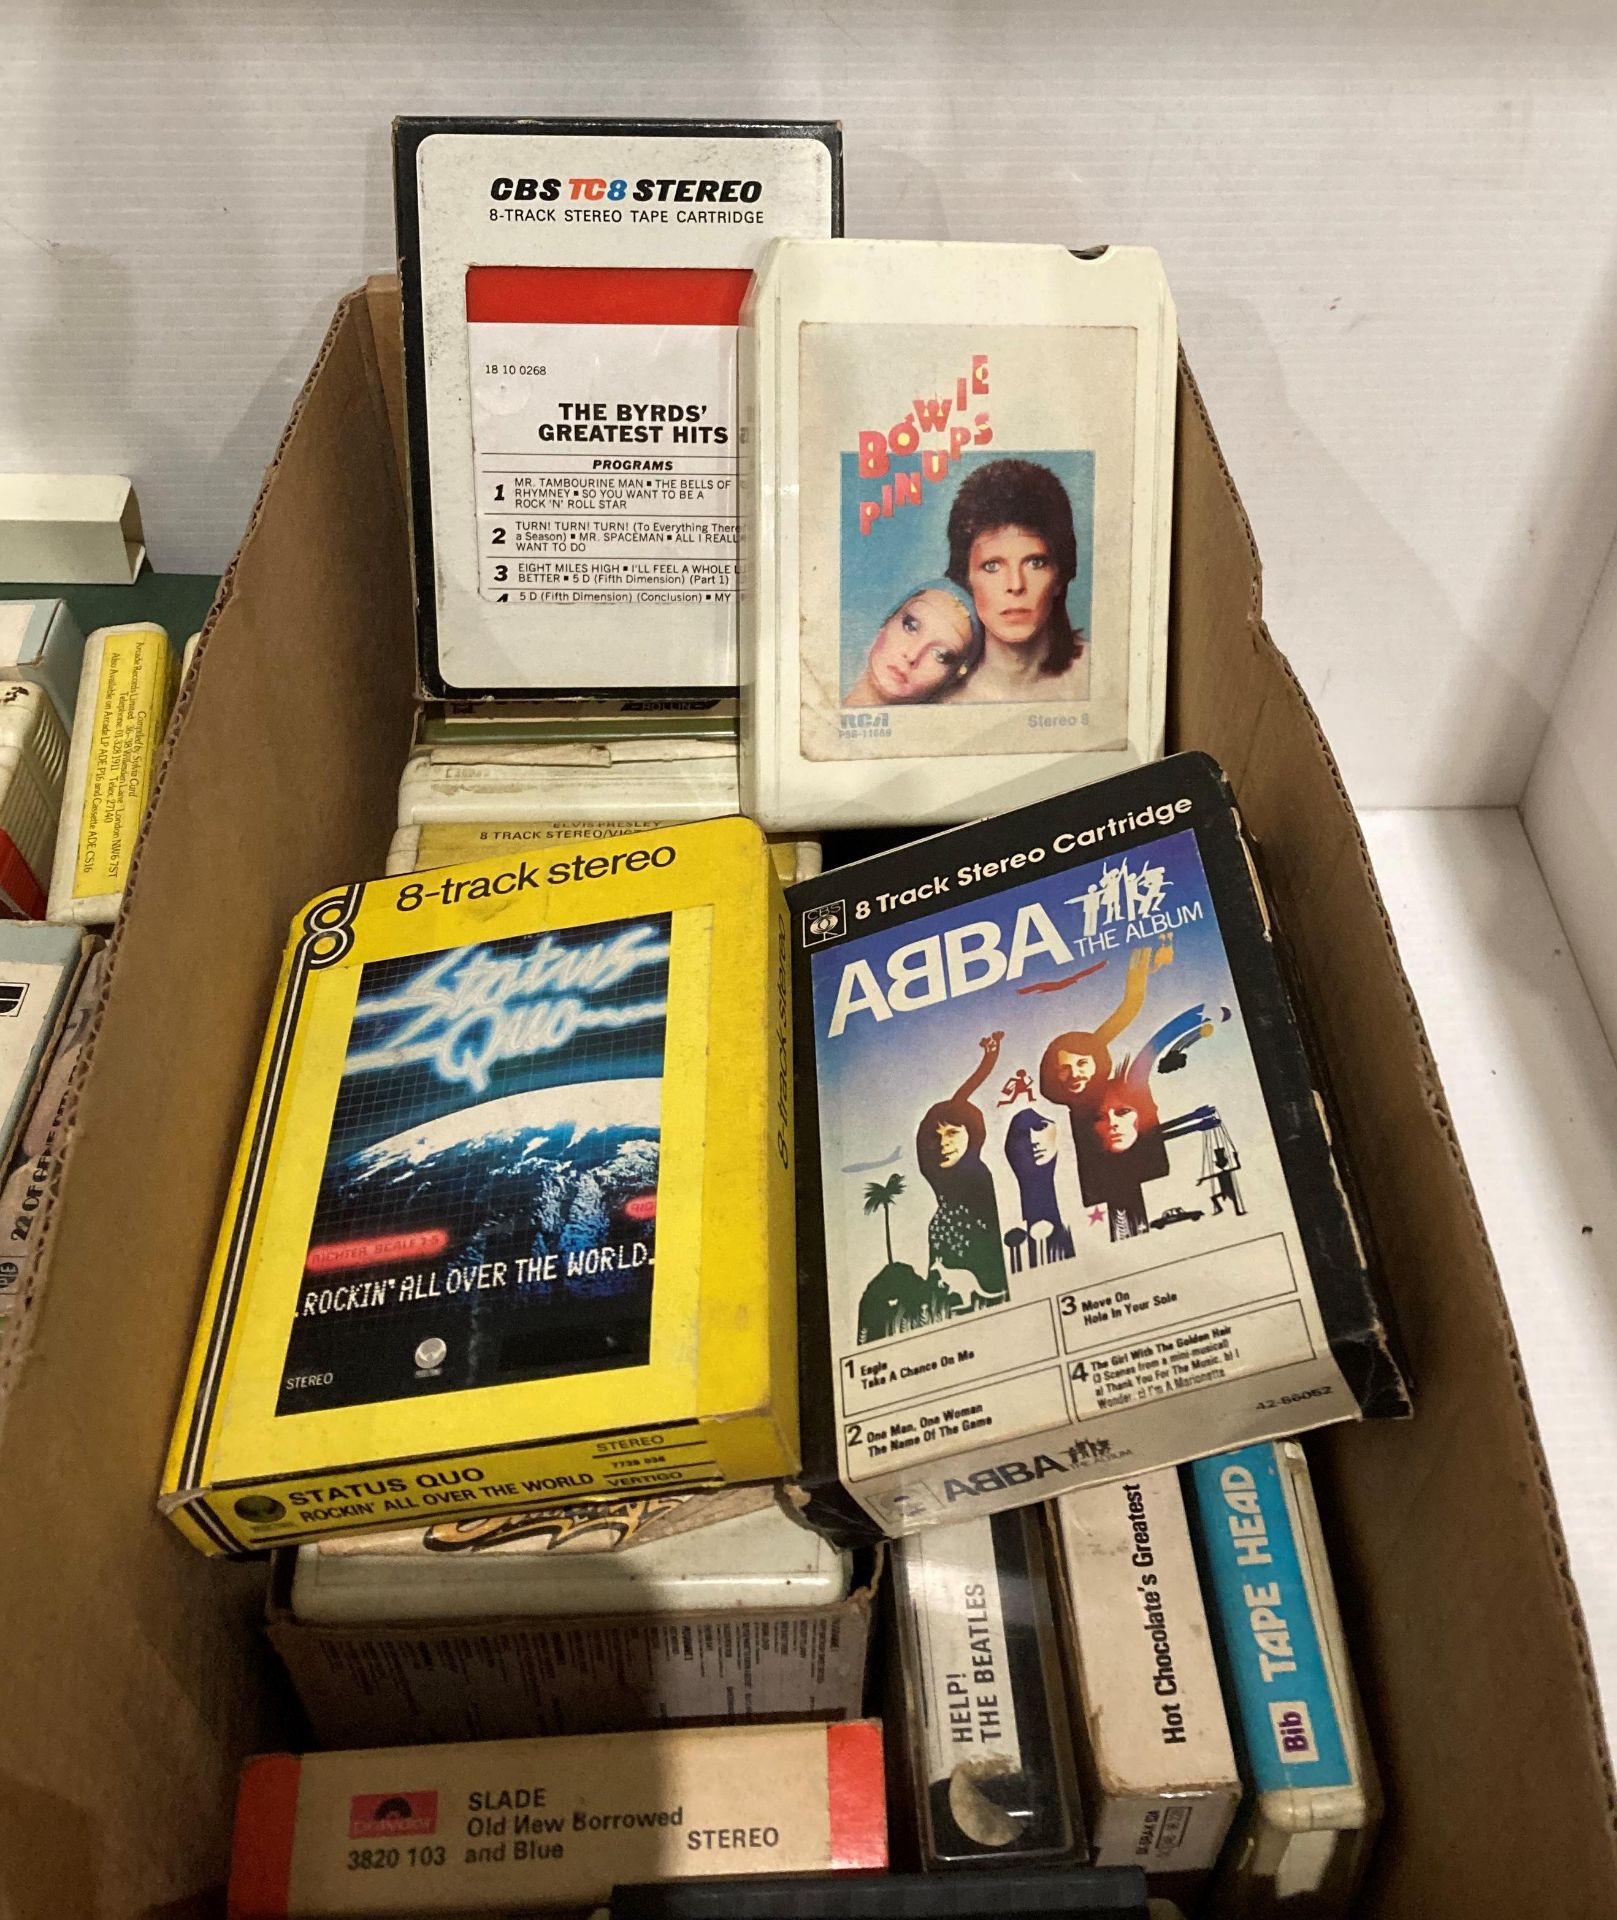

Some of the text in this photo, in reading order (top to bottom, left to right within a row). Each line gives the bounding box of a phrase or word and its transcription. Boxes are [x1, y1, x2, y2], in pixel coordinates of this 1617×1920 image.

[490, 178, 762, 203] CBS TC8 STEREO
[489, 208, 764, 224] 8-TRACK STEREO TAPE CARTRIDGE
[485, 365, 547, 376] 18 10 0268
[559, 403, 708, 422] THE BYRDS'
[858, 354, 989, 478] BOWIE
[538, 424, 729, 444] GREATEST HITS
[592, 460, 674, 471] PROGRAMS
[494, 484, 505, 501] 1
[515, 488, 694, 500] RHYMNEY SO YOU WANT TO BE
[540, 478, 732, 490] TAMBOURINE MAN THE BELLS OF
[516, 500, 627, 509] ROCK ROLL STAR
[492, 528, 506, 544] 2
[516, 522, 708, 533] TURN! TURN! TURN! (To Everything
[525, 532, 695, 542] Season) SPACEMAN ALL
[516, 542, 586, 552] WANT TO DO
[494, 564, 508, 582] 3
[518, 563, 731, 574] EIGHT MILES HIGH FEEL WHOLE
[518, 574, 716, 585] BETTER (Fifth Dimension) (Part
[540, 592, 732, 603] (Fifth Dimension) (Conclusion) MY
[840, 712, 889, 728] RCA
[1028, 712, 1090, 728] Stereo 8
[96, 748, 107, 766] ADE
[112, 808, 125, 838] London
[86, 830, 97, 849] ADE
[480, 831, 542, 840] 8 TRACK
[83, 850, 95, 872] CS16
[807, 796, 1193, 921] CBS 8 Track Stereo Cartridge
[107, 861, 119, 878] 7ST
[396, 844, 676, 912] 8-track stereo
[1073, 901, 1204, 958] THE ALBUM
[828, 902, 1074, 1039] ABBA
[10, 1215, 34, 1242] 22
[399, 1272, 441, 1304] ALL
[446, 1262, 506, 1294] OVER
[516, 1254, 558, 1284] THE
[1061, 1296, 1077, 1316] 3
[1082, 1292, 1130, 1313] Move On
[1084, 1312, 1108, 1326] Hole
[1112, 1308, 1122, 1319] In
[1124, 1302, 1150, 1314] Your
[1090, 1325, 1232, 1372] The Girl With The Golden Hair
[844, 1360, 854, 1379] 1
[860, 1360, 888, 1377] Eagle
[862, 1350, 975, 1390] Take Chance On Me
[1072, 1362, 1089, 1382] 4
[286, 1371, 334, 1391] STEREO
[867, 1430, 888, 1444] One
[920, 1416, 940, 1428] One
[943, 1404, 984, 1422] Woman
[596, 1434, 664, 1452] STEREO
[848, 1424, 863, 1447] 2
[868, 1416, 992, 1458] The Name Of The Game
[288, 1467, 486, 1507] STATUS QUO
[944, 1454, 1070, 1503] ABBA
[382, 1494, 420, 1512] ALL
[422, 1487, 478, 1509] OVER
[483, 1480, 520, 1499] THE
[524, 1470, 594, 1494] WORLD
[1220, 1464, 1296, 1683] TAPE HEAD
[1122, 1482, 1186, 1744] Hot Chocolate's Greatest
[965, 1582, 1002, 1744] THE BEATLES
[946, 1673, 974, 1742] HELP!
[1278, 1710, 1310, 1753] Bib
[468, 1788, 546, 1812] SLADE
[466, 1806, 684, 1838] Old New Borrowed
[687, 1826, 779, 1850] STEREO
[348, 1846, 446, 1871] 3820 103
[464, 1840, 564, 1864] and Blue
